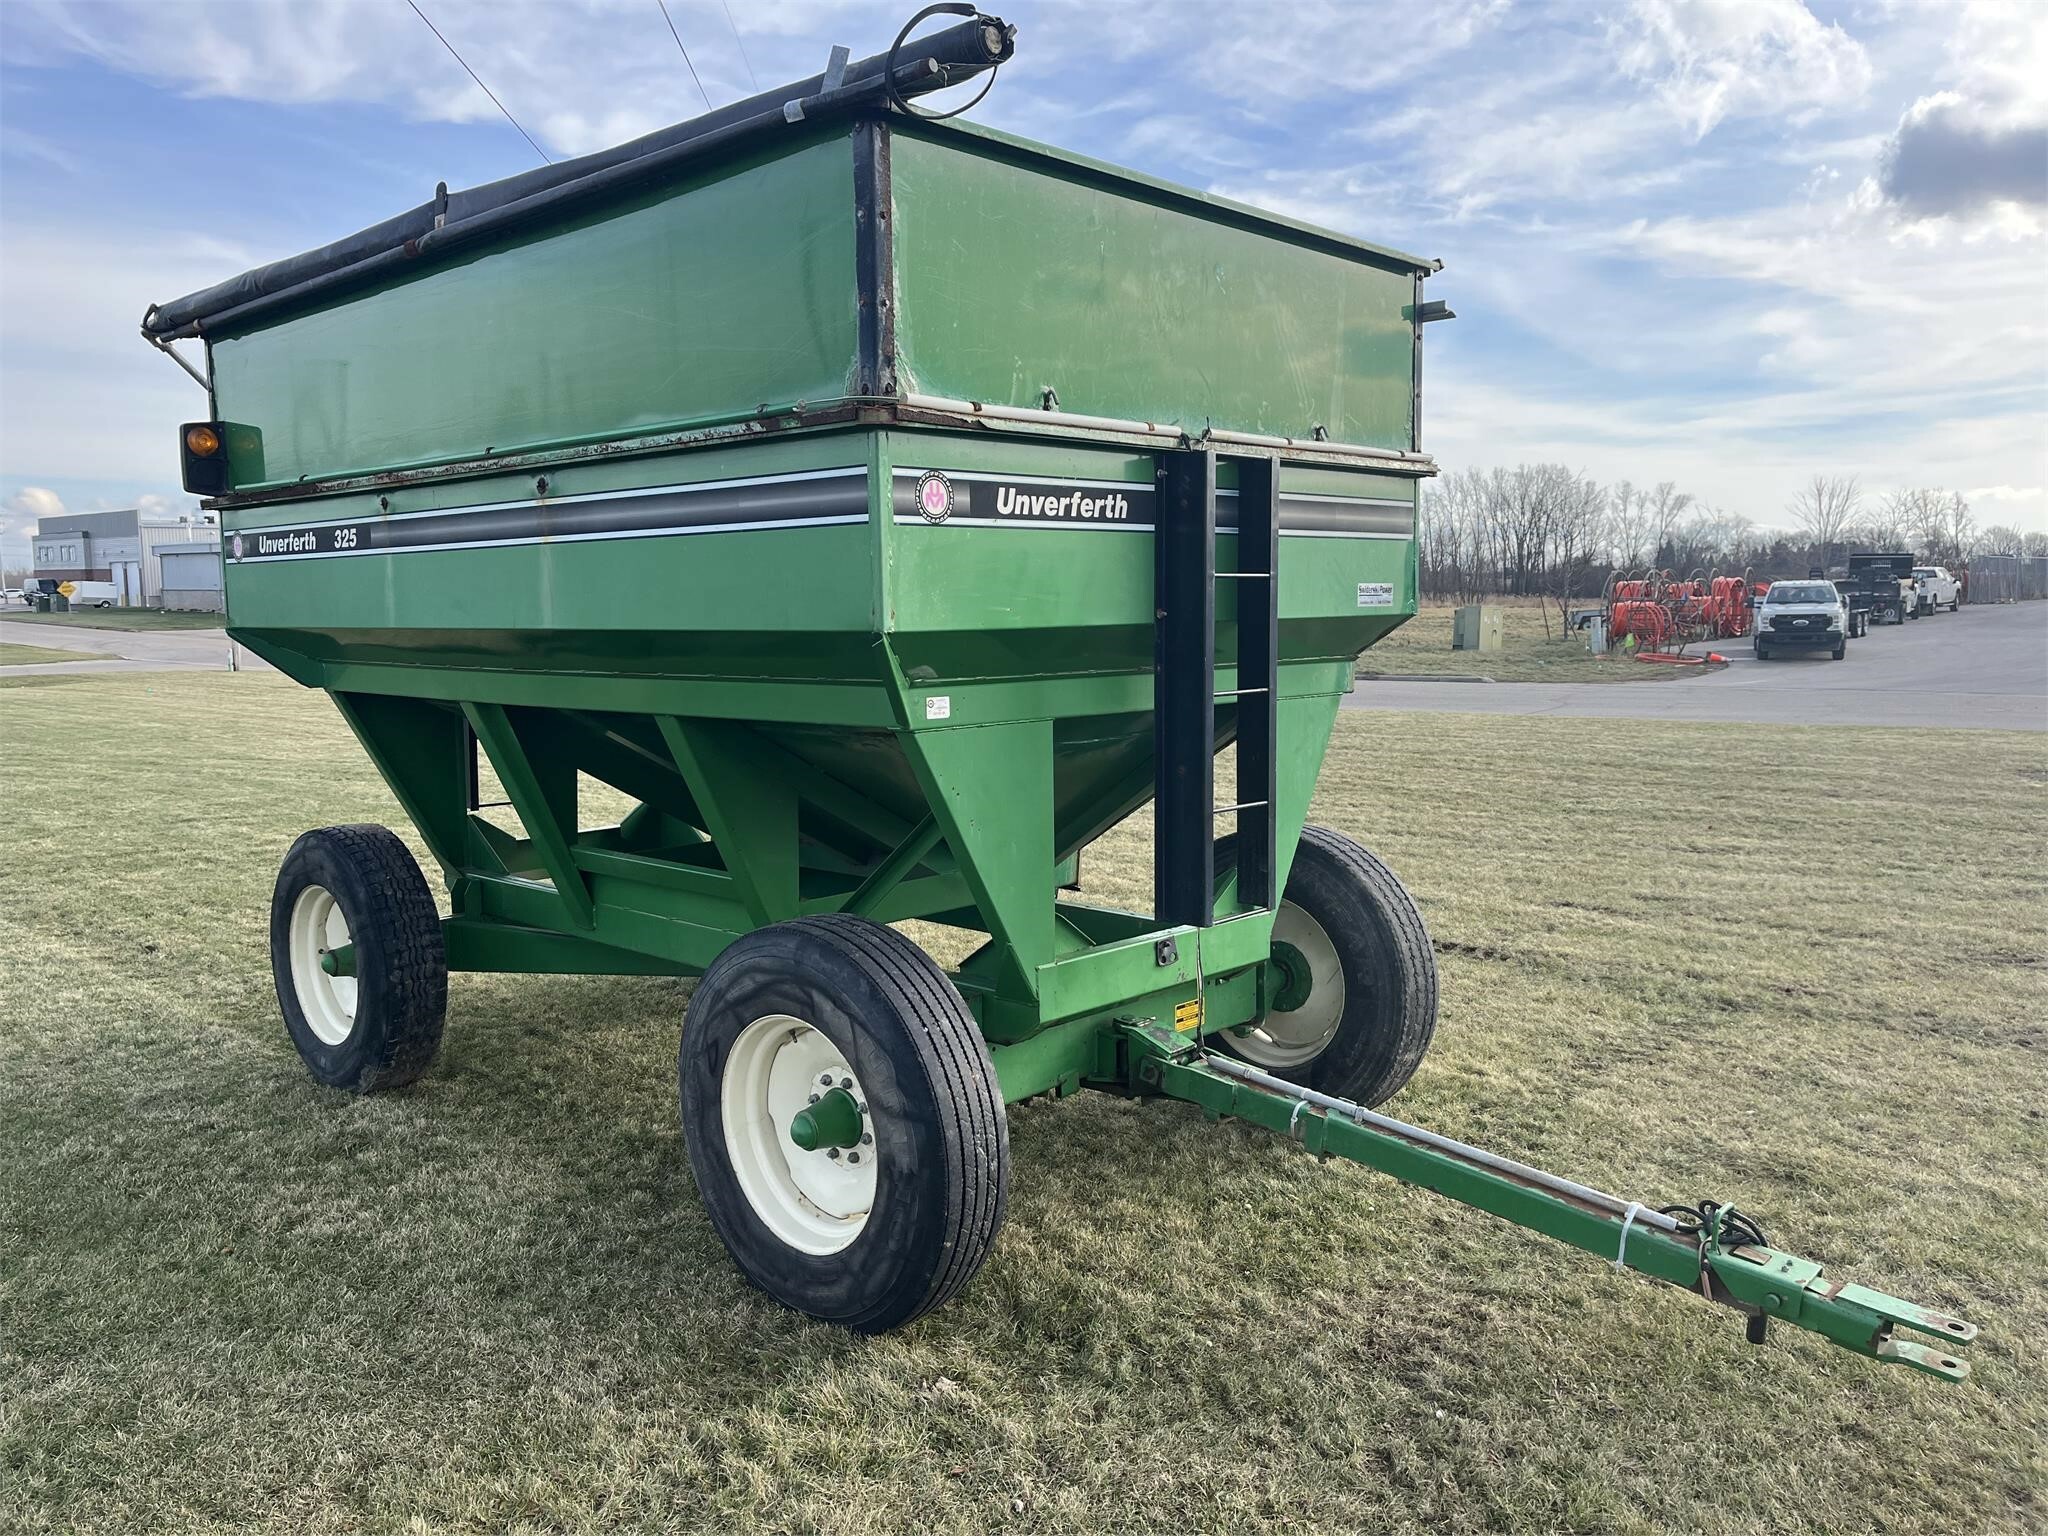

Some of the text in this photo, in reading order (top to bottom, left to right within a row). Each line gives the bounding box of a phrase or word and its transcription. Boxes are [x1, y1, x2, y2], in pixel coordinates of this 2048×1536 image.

[997, 487, 1128, 519] Unverferth
[259, 528, 357, 554] Unverferth 325
